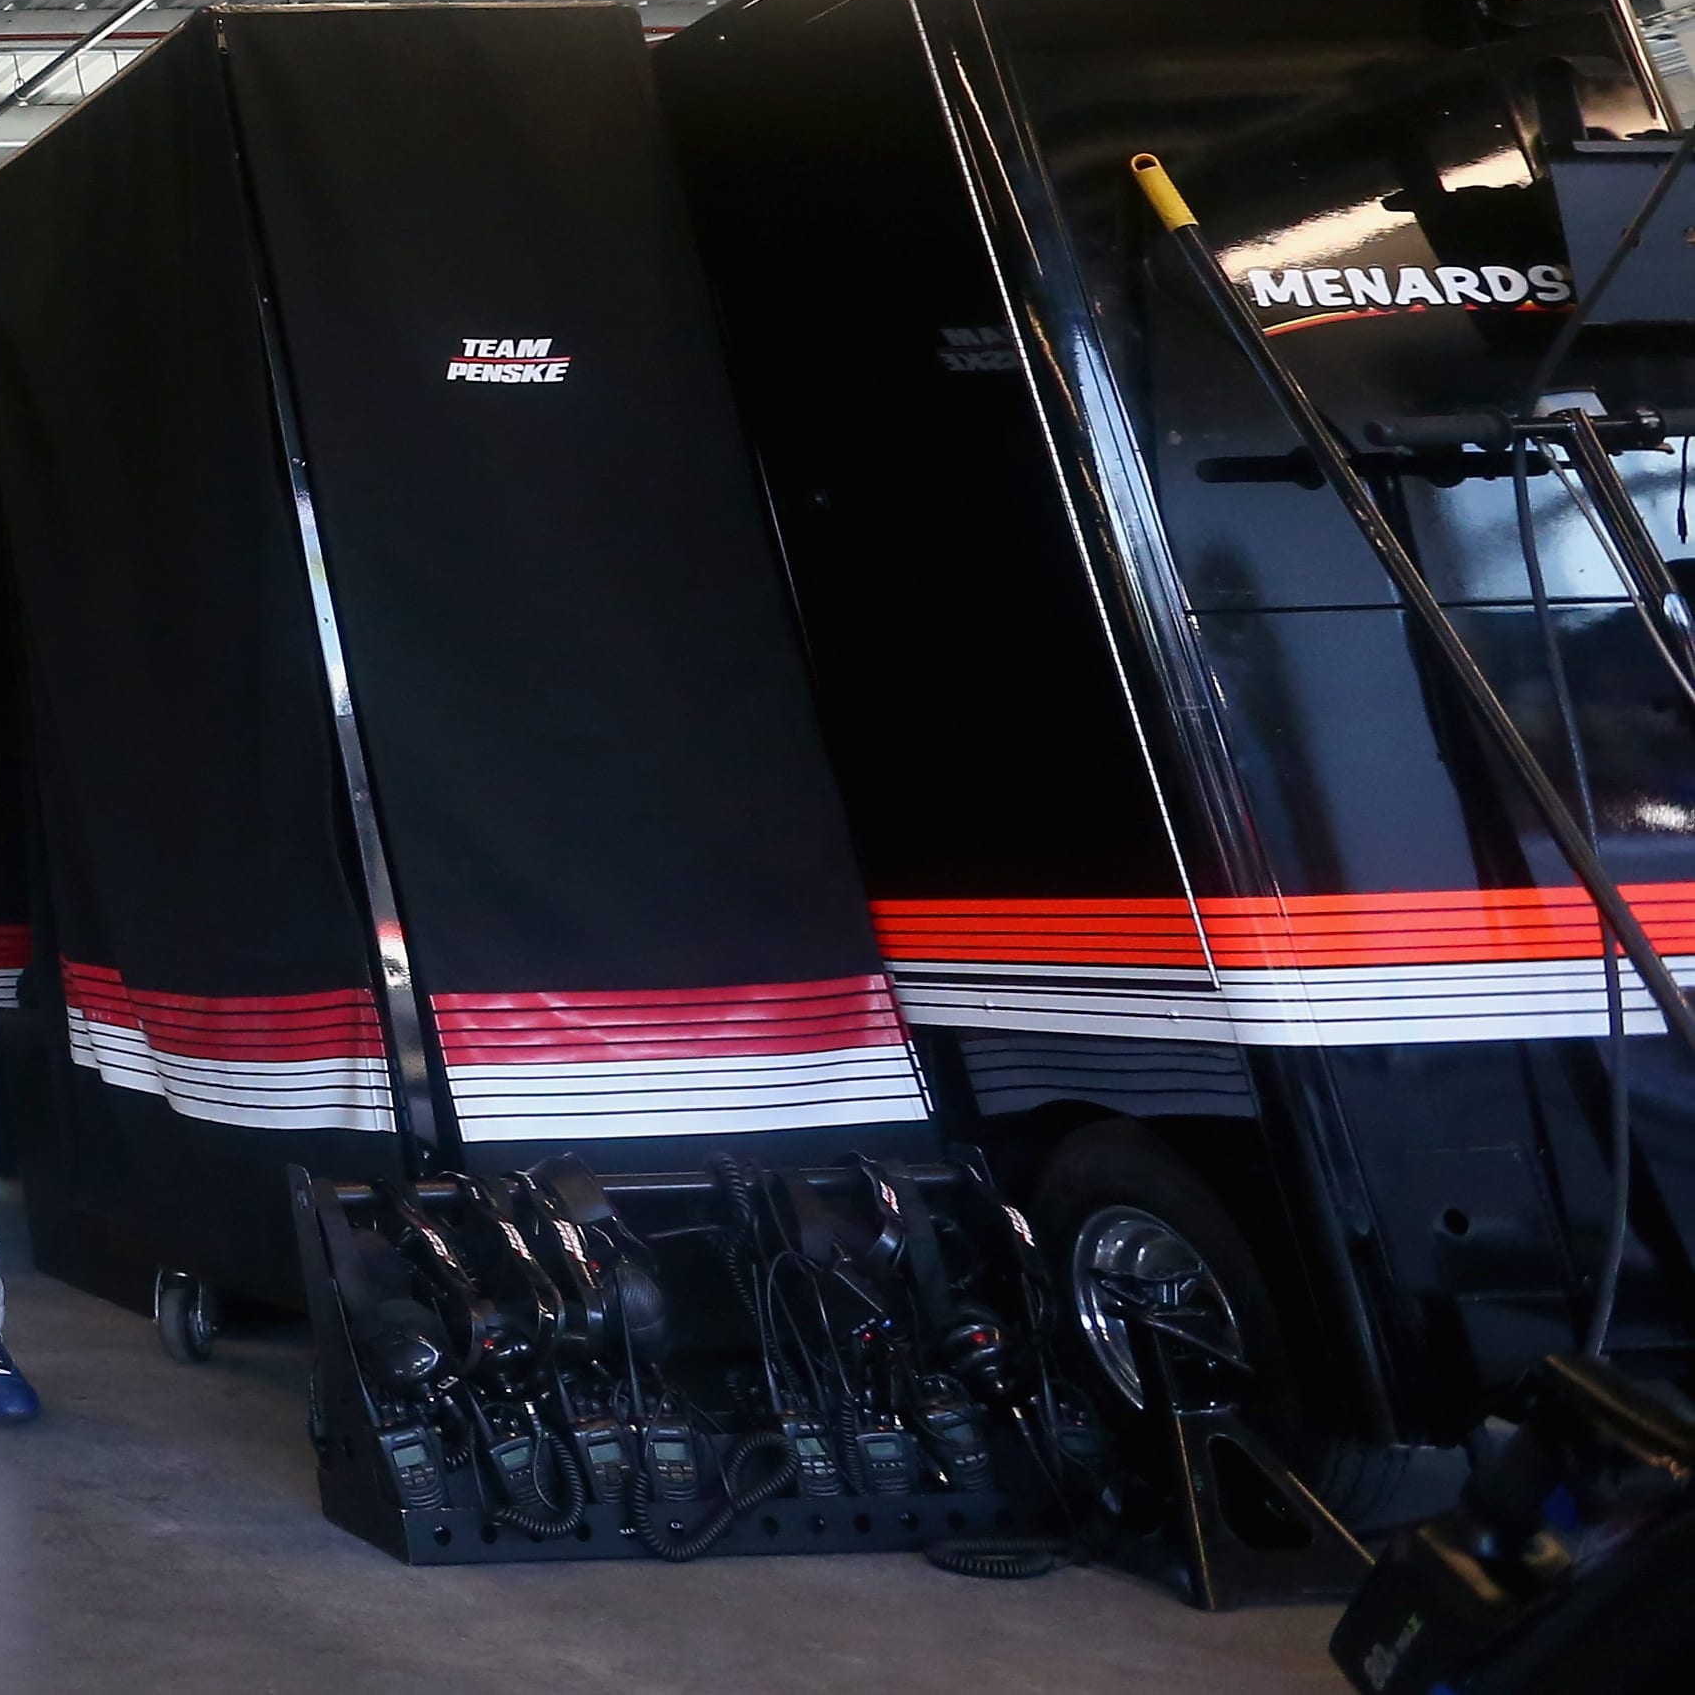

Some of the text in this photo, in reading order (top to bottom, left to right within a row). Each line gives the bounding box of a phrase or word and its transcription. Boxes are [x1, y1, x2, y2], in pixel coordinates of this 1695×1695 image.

[1248, 264, 1571, 307] MENARDS
[462, 338, 552, 358] TEAM
[446, 362, 569, 383] PENSKE
